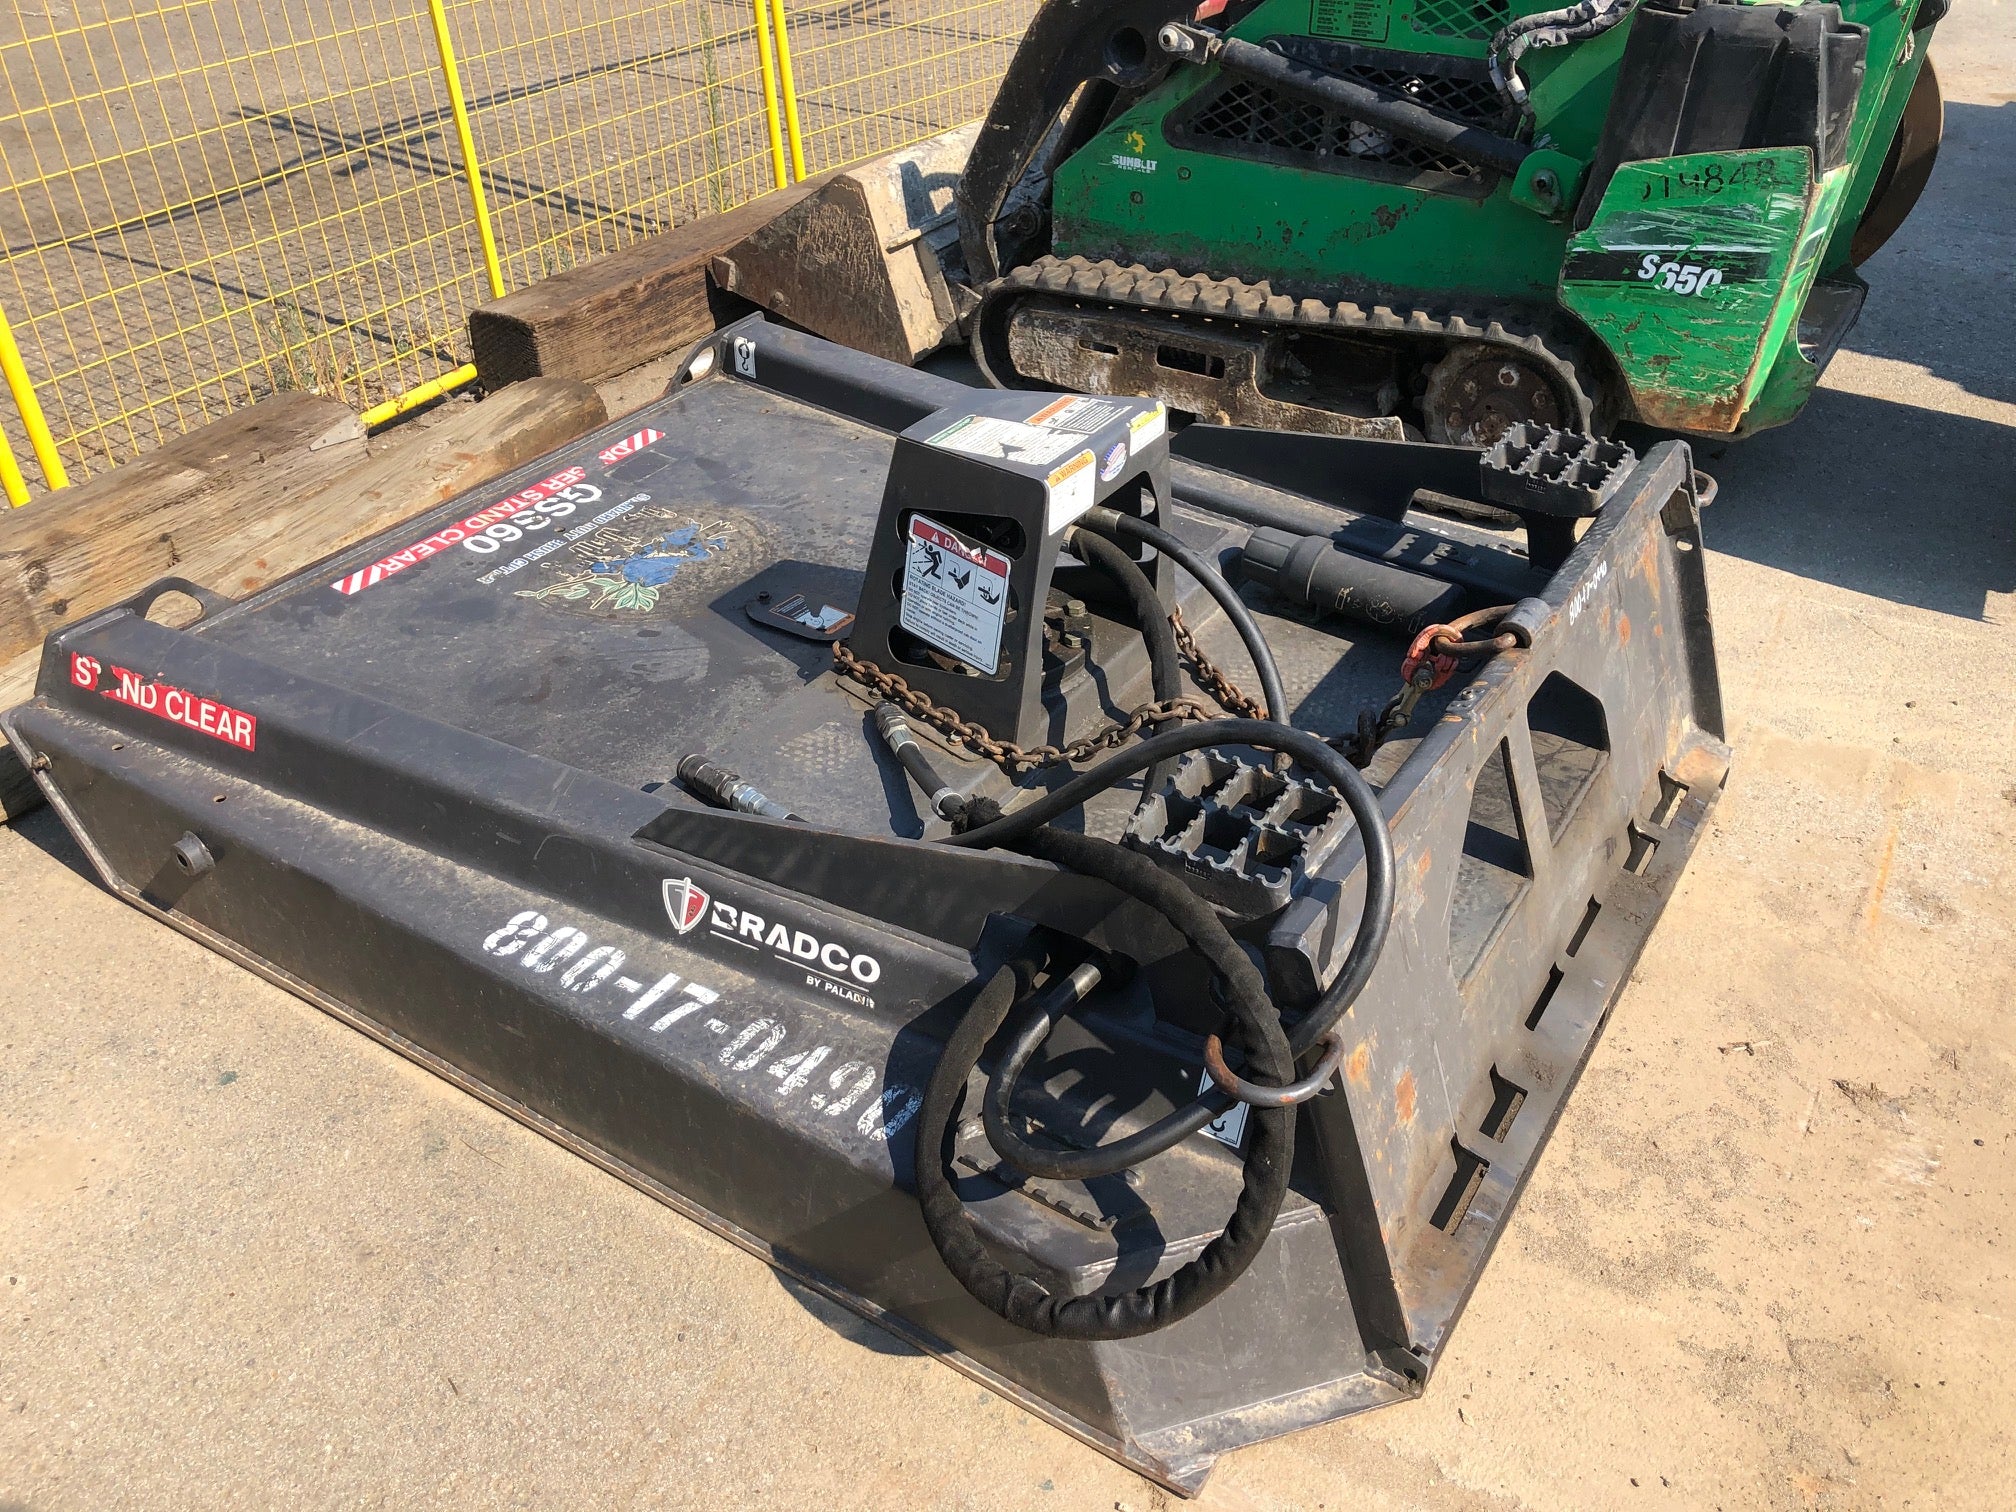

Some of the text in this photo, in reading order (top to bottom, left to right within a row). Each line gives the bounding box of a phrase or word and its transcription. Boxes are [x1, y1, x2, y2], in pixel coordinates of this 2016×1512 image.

[1637, 254, 1723, 298] S650
[464, 487, 543, 531] STAND
[378, 526, 460, 573] CLEAR
[165, 690, 253, 747] CLEAR
[711, 900, 881, 984] BRADCO
[806, 974, 822, 990] BY
